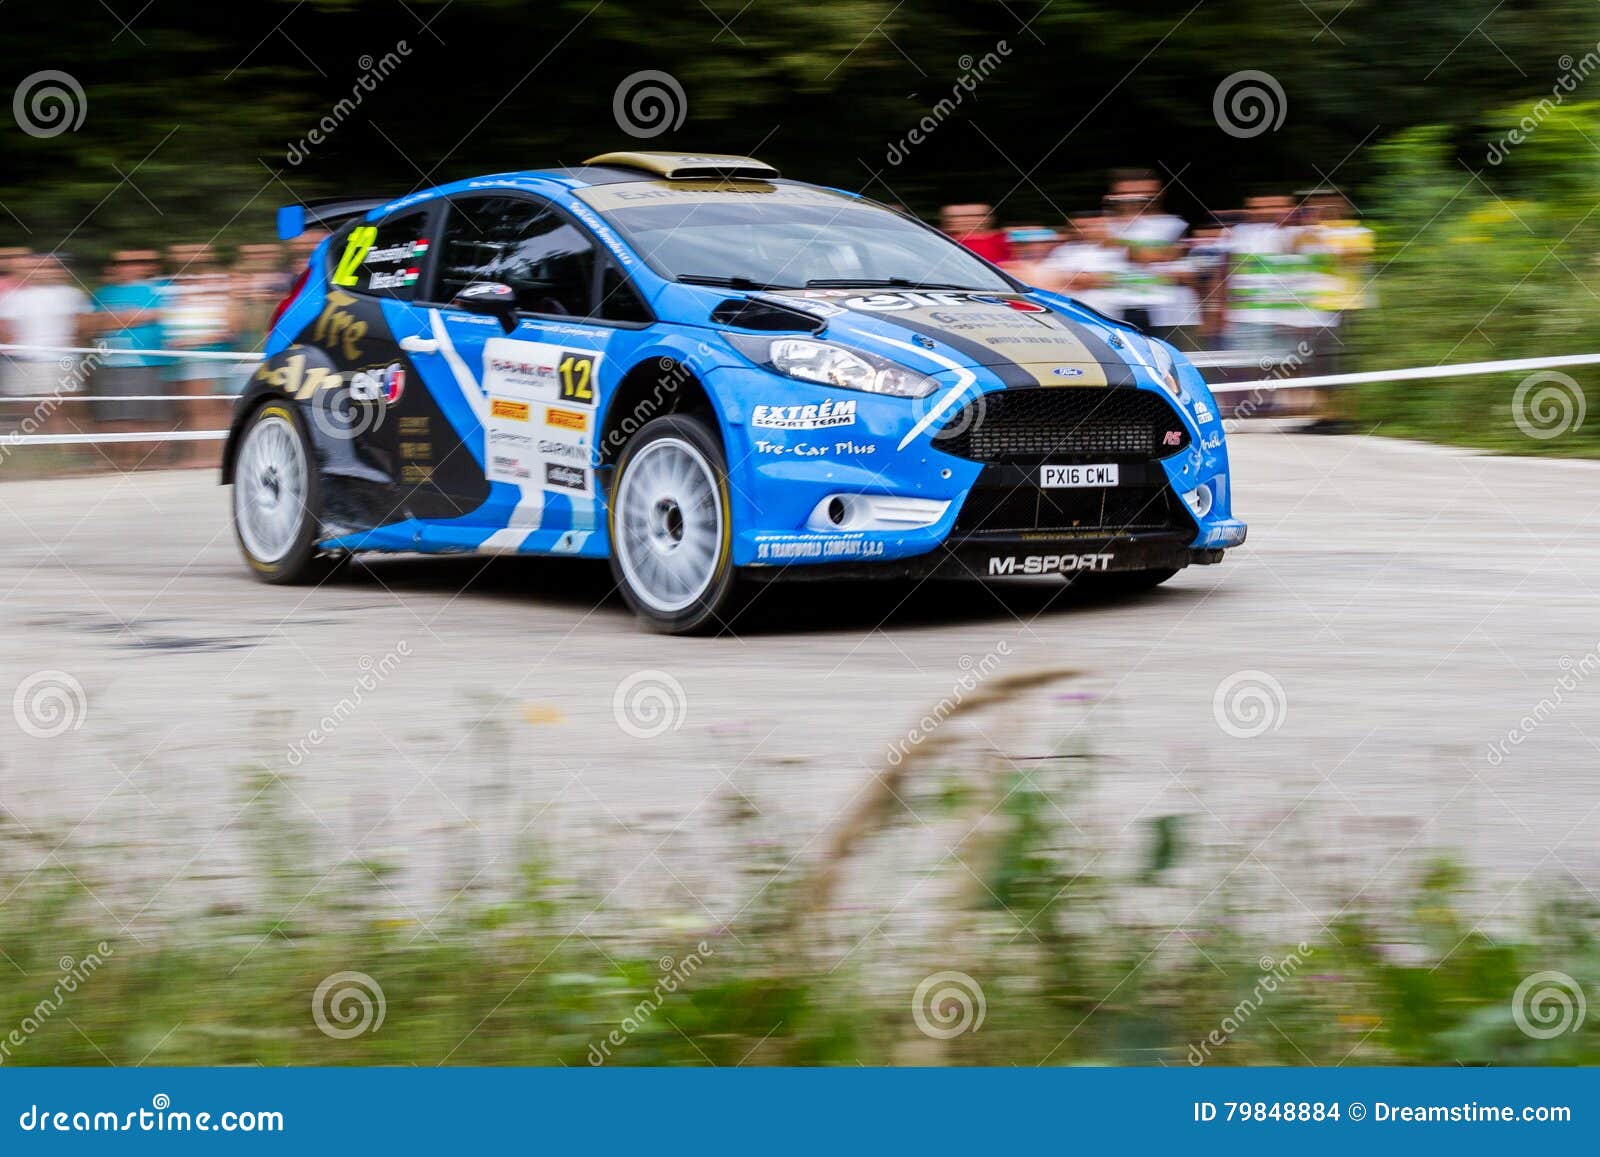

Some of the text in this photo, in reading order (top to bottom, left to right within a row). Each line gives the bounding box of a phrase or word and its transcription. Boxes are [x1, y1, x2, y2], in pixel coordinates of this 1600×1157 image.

[331, 226, 378, 287] 12
[559, 357, 593, 399] 12
[752, 398, 857, 421] EXTRÉM
[756, 416, 851, 428] SPORT TEAM
[755, 441, 876, 456] Tre-Car Plus
[1046, 467, 1114, 484] PX16 CWL
[989, 553, 1115, 576] M-SPORT
